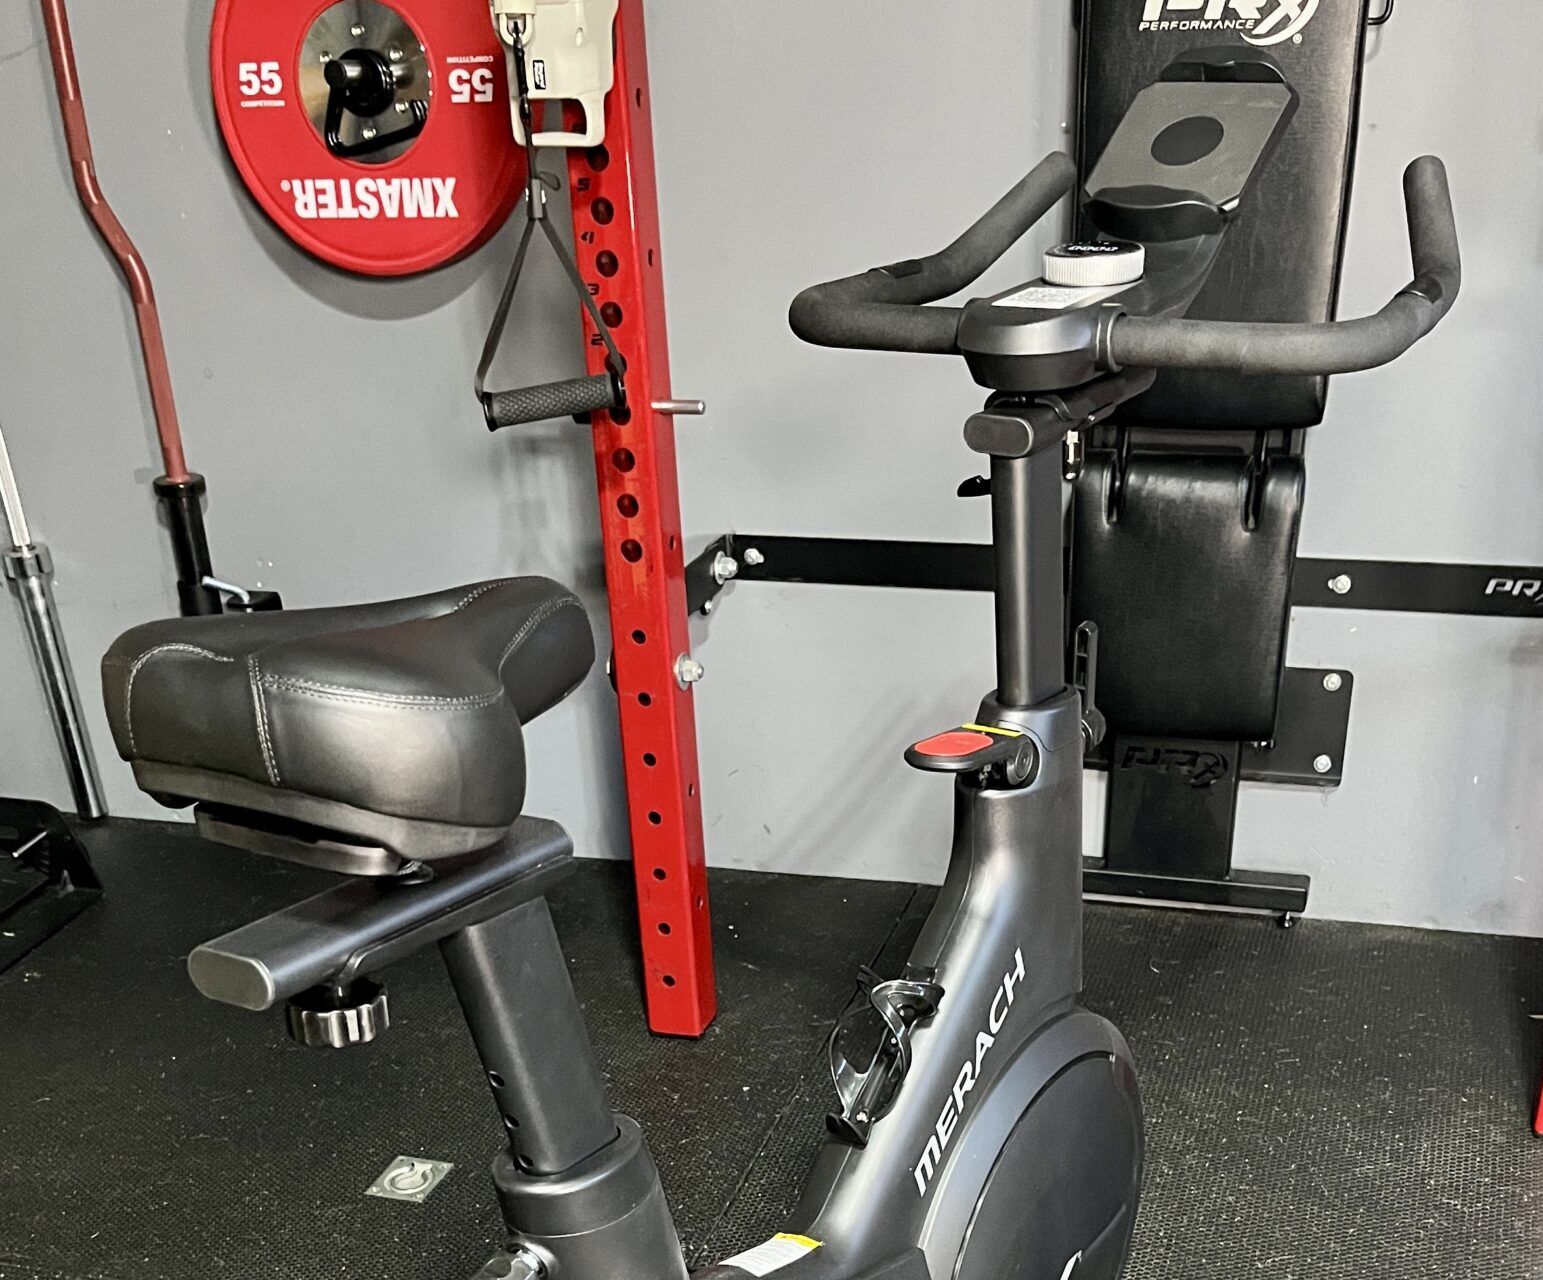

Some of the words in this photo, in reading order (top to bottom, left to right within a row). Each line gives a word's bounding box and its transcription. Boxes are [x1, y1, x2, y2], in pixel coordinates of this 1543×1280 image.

[1138, 19, 1256, 31] PERFORMANCE
[238, 62, 283, 96] 55
[448, 68, 494, 103] 55
[577, 177, 591, 192] 5
[588, 283, 600, 296] 3
[591, 333, 604, 346] 2
[1485, 578, 1543, 602] PR
[913, 947, 1026, 1198] MERACH
